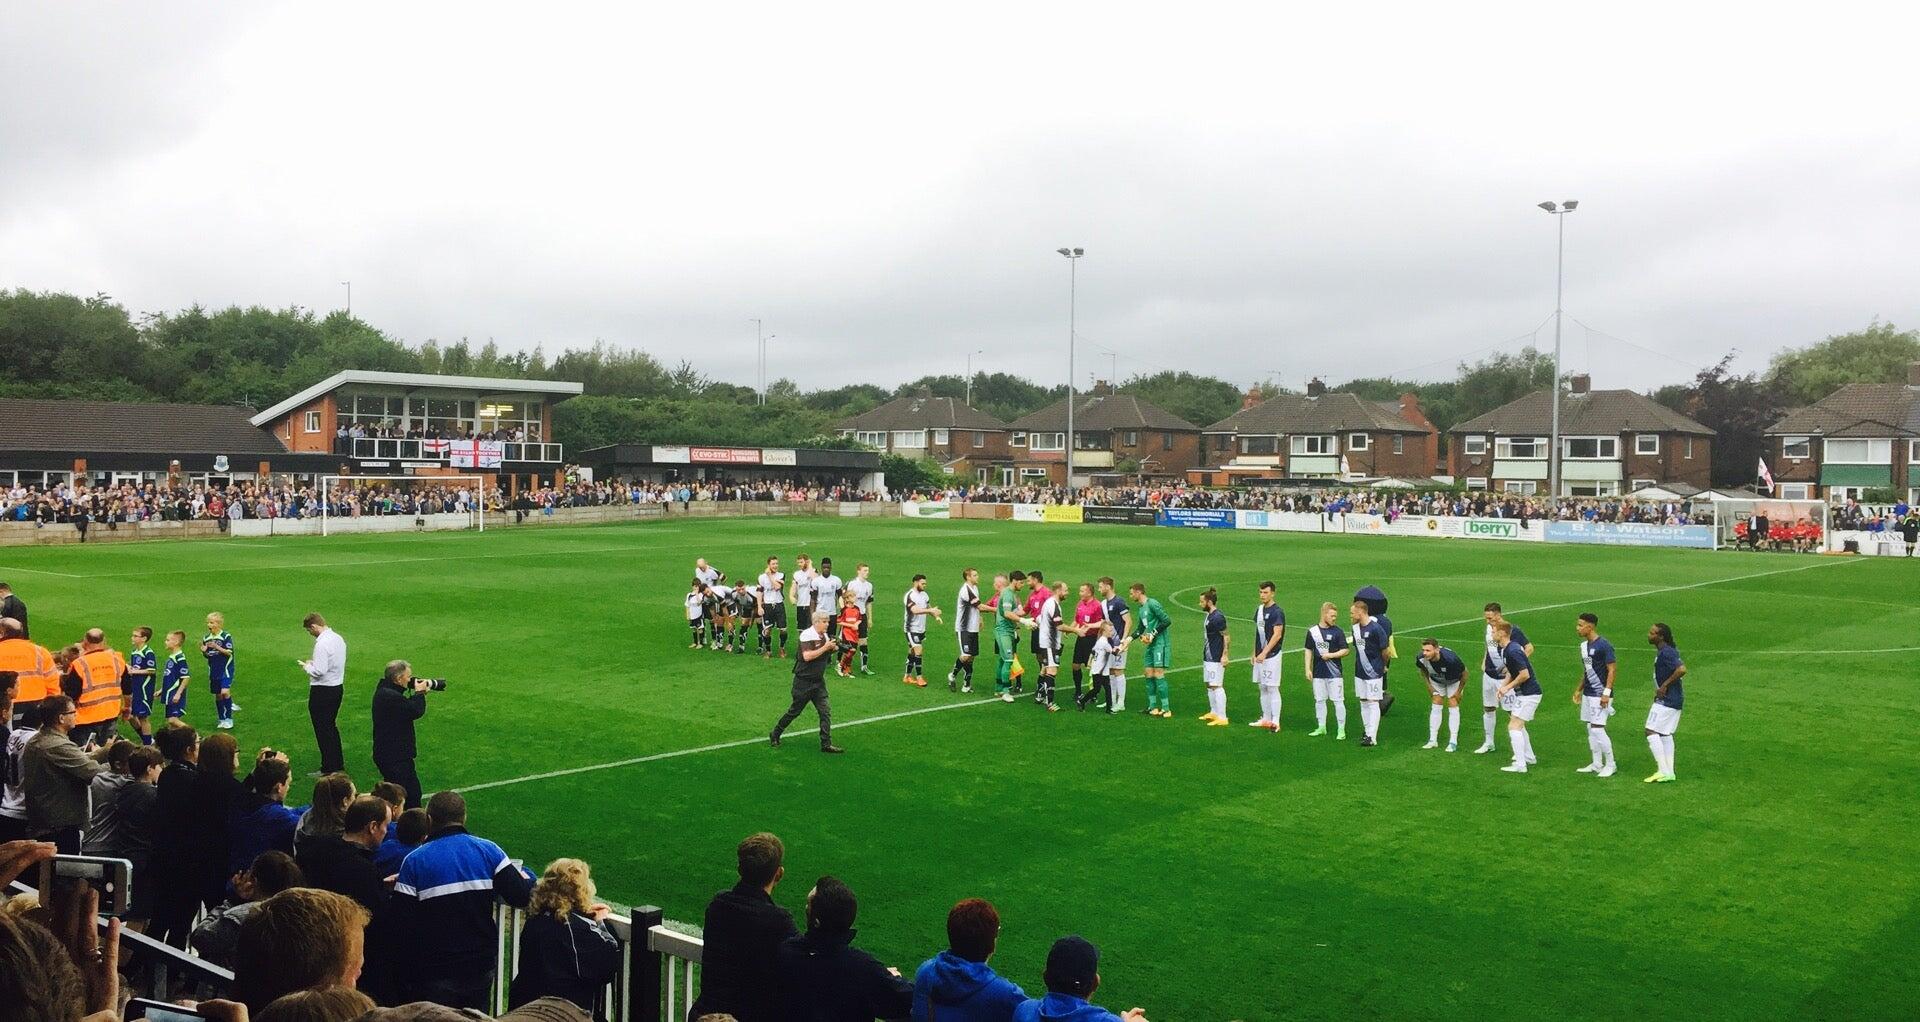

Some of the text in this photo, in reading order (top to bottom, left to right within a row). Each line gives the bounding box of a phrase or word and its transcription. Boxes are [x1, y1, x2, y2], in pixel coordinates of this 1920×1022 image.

[699, 451, 729, 459] EVO-STIK
[764, 454, 793, 463] Glover's
[1347, 521, 1370, 530] Wilde
[1470, 521, 1512, 537] berry
[1572, 523, 1685, 535] B. J. Watson
[1869, 533, 1903, 541] EVANS
[1262, 669, 1273, 680] 32
[1338, 686, 1343, 695] 7
[1369, 683, 1379, 693] 16
[1503, 694, 1515, 705] 20
